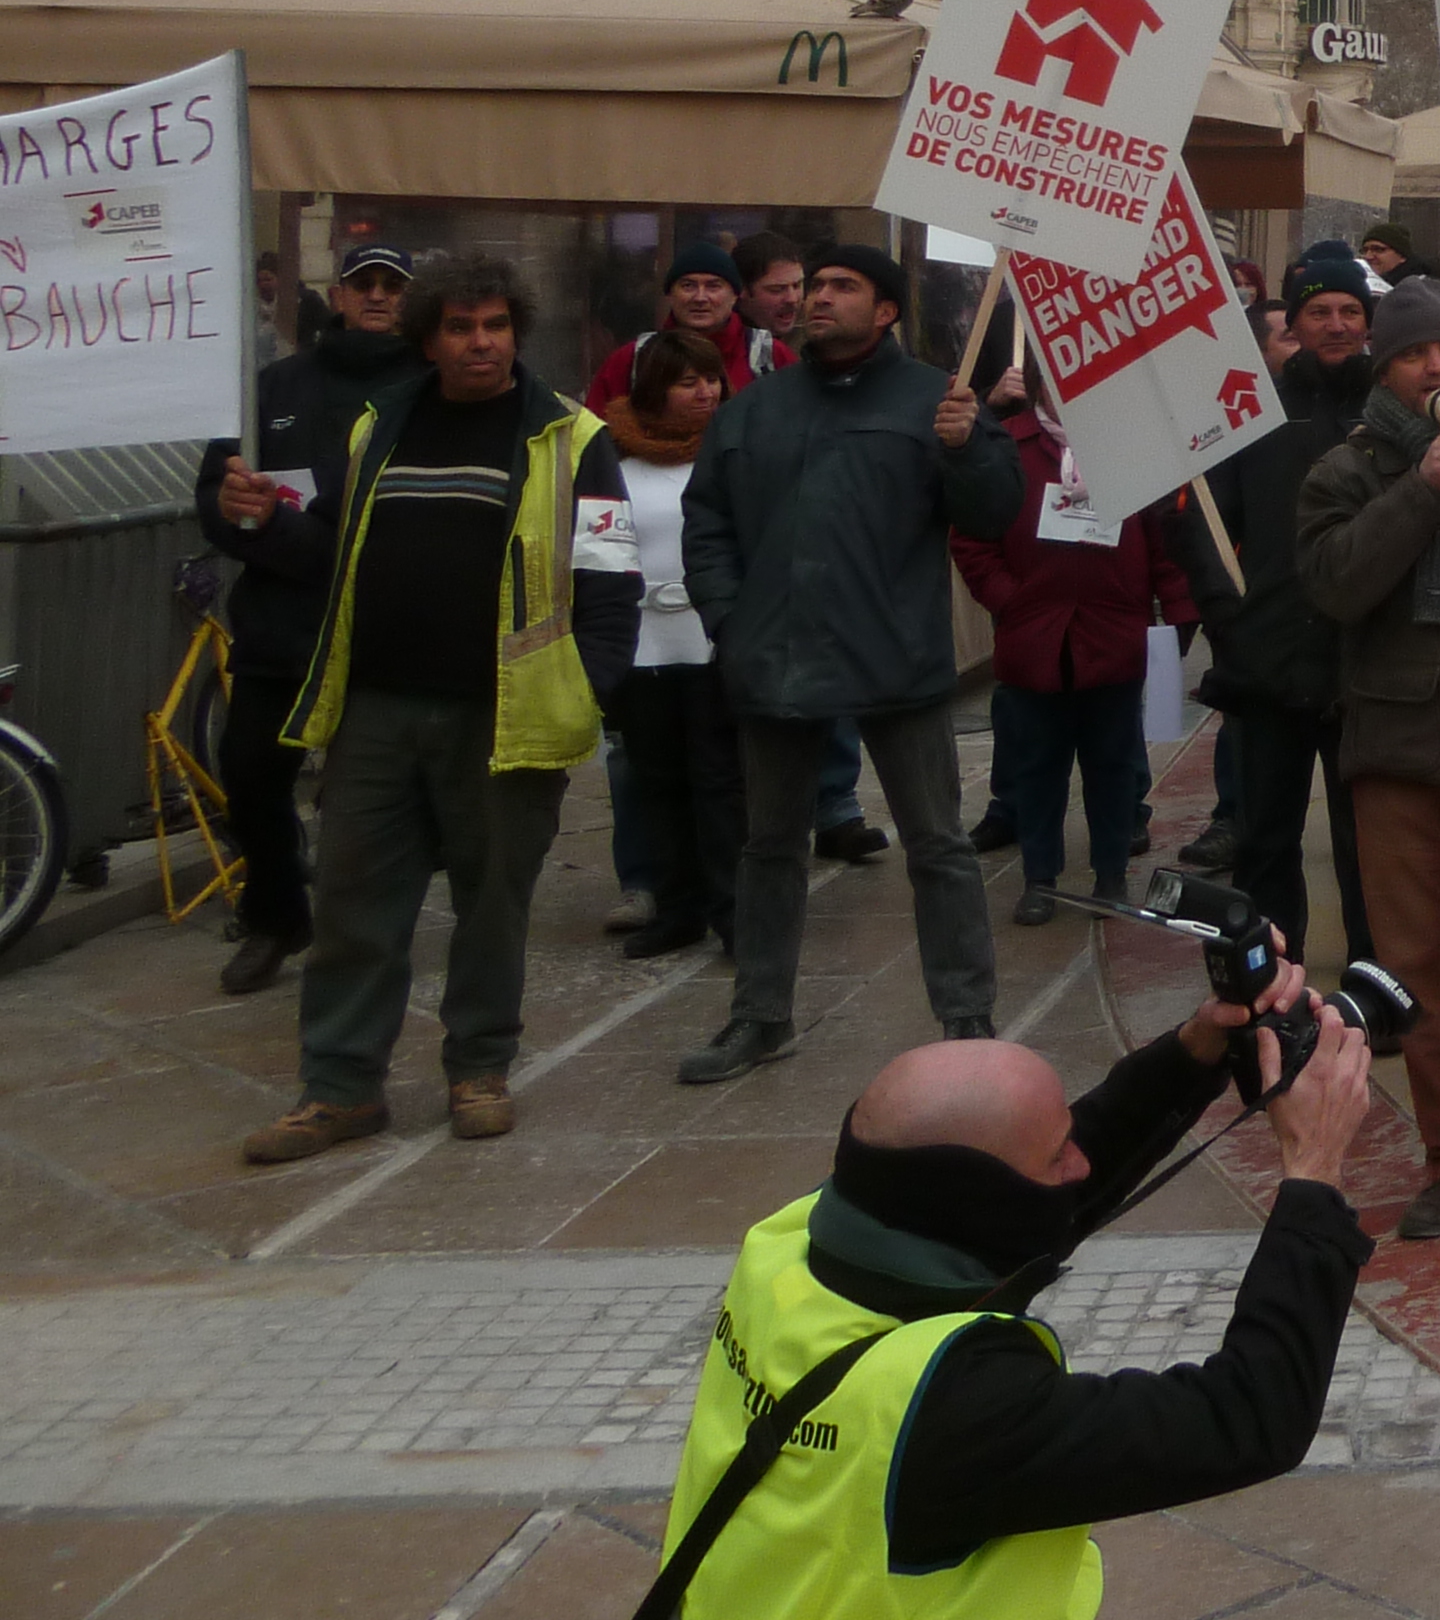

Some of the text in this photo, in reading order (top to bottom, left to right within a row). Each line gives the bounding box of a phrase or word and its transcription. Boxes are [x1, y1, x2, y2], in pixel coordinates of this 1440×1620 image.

[915, 107, 1160, 197] NOUS EMPÊCHENT
[929, 75, 1169, 173] VOS MESURES
[106, 203, 161, 221] CAPEB
[906, 132, 1151, 225] DE CONSTRUIRE
[1023, 260, 1058, 302] DU
[1034, 286, 1081, 336] EN
[1049, 254, 1214, 380] DANGER
